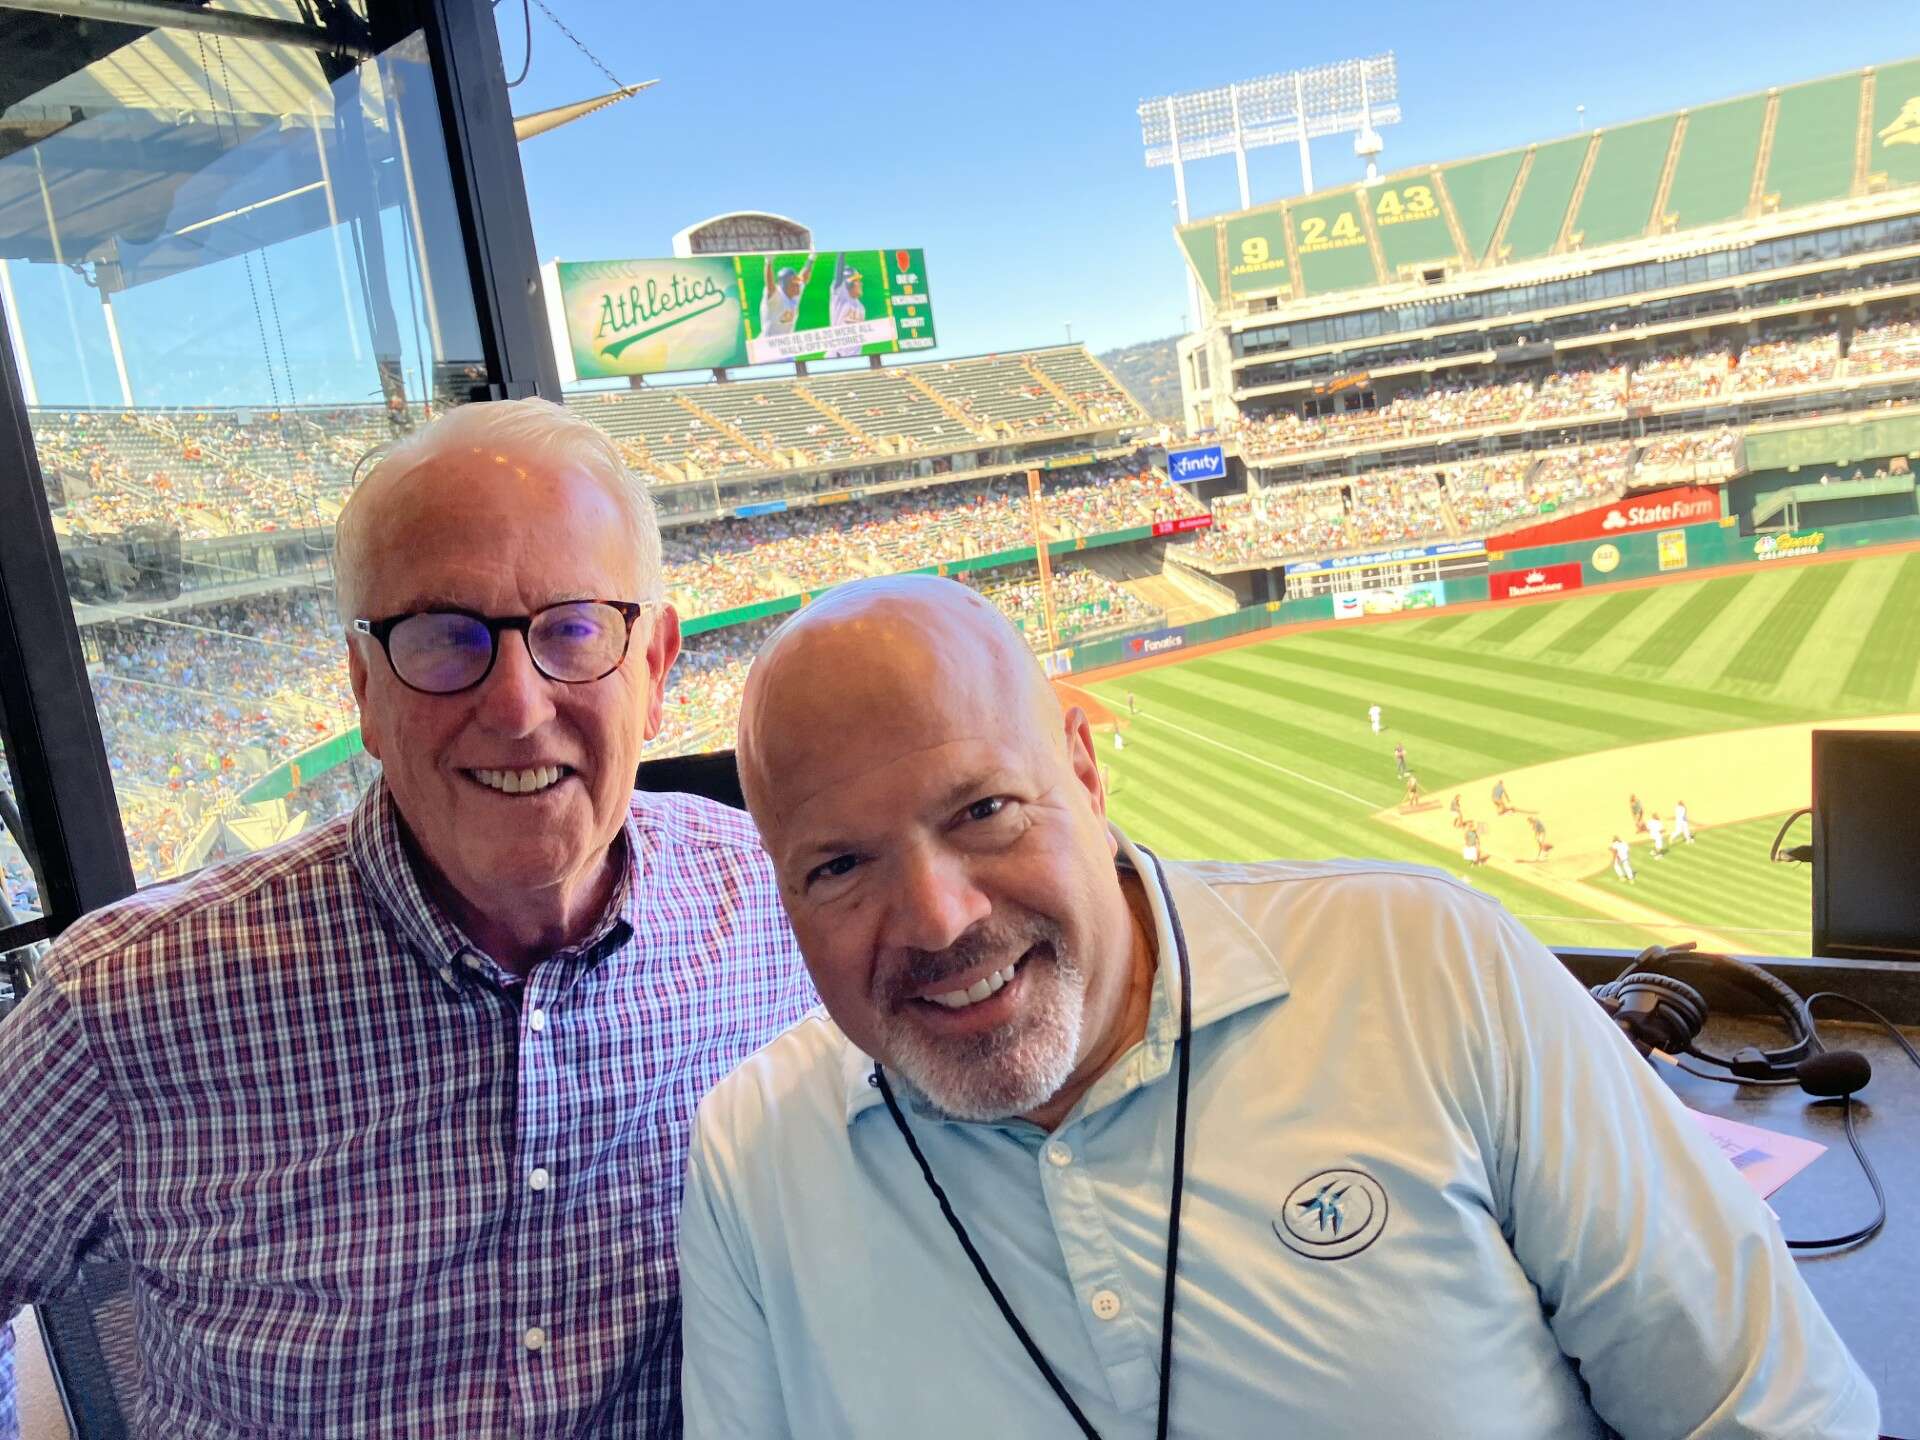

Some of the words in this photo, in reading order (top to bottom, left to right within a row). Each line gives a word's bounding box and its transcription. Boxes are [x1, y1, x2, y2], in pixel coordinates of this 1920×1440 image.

[1376, 185, 1435, 216] 43
[1301, 212, 1361, 245] 24
[1241, 237, 1269, 264] 9
[1231, 259, 1285, 275] JACKSON
[595, 273, 725, 339] Athletics
[1172, 454, 1219, 476] xfinity
[1508, 581, 1563, 598] Budweiser
[1143, 635, 1182, 652] Fanatics
